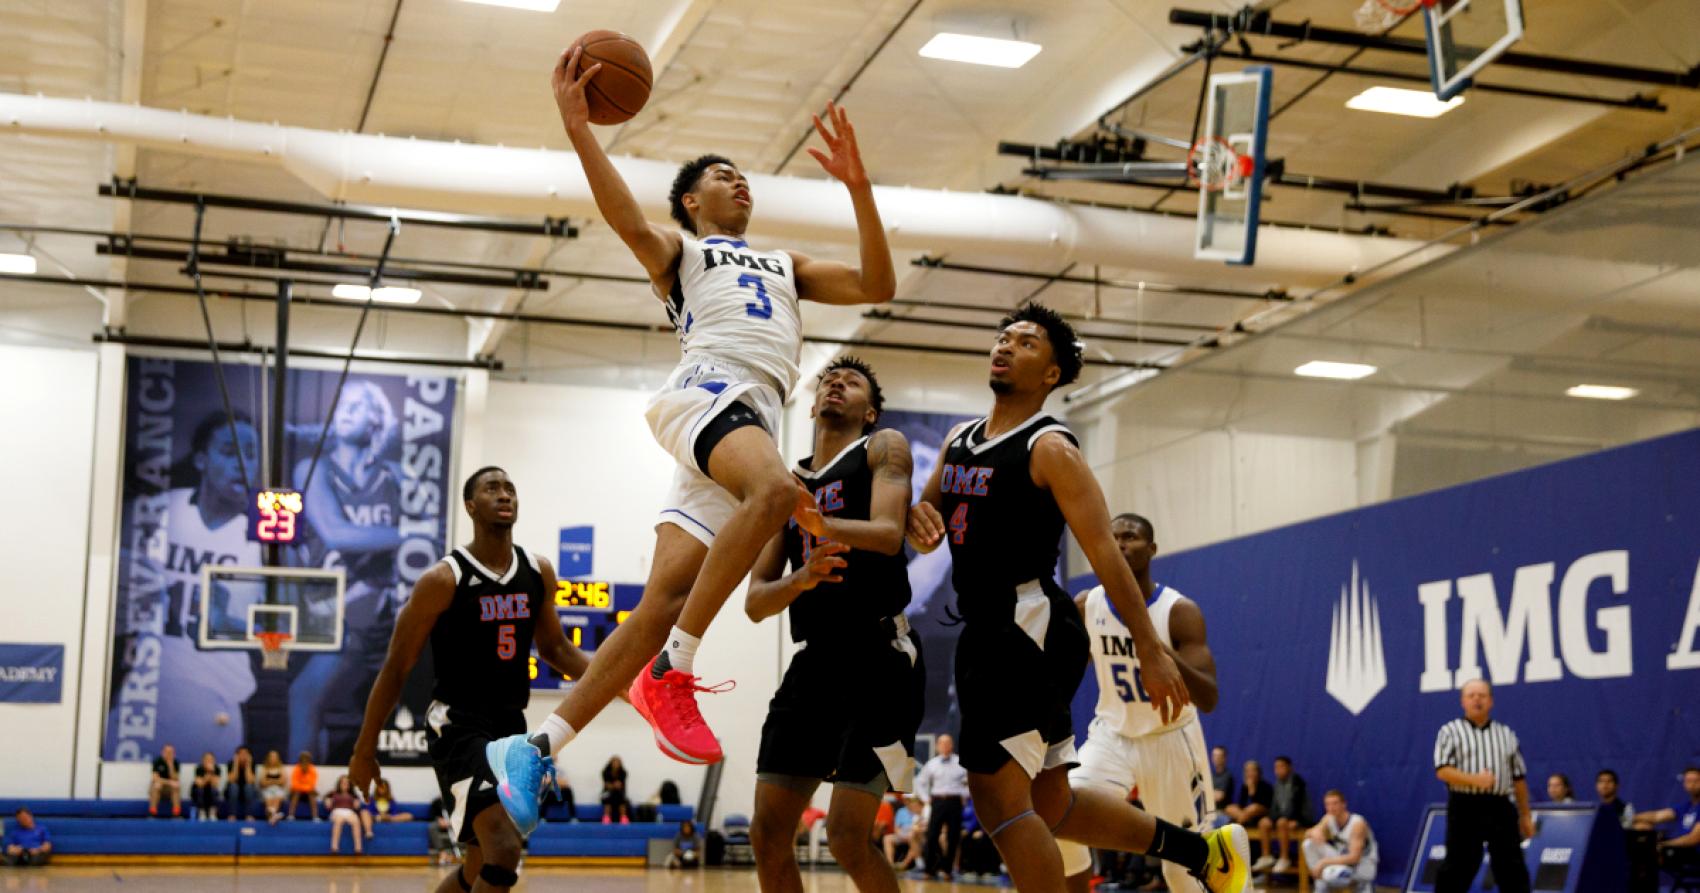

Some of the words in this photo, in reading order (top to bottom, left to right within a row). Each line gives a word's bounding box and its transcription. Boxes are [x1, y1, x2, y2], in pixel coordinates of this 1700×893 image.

[702, 248, 785, 277] IMG
[738, 273, 772, 320] 3
[397, 375, 447, 602] PASSIO
[940, 464, 993, 496] DME
[257, 509, 296, 541] 23
[343, 503, 391, 528] MG
[950, 502, 968, 544] 4
[480, 594, 530, 621] DME
[554, 580, 610, 608] 2:46
[1418, 550, 1632, 692] IMG
[497, 625, 516, 659] 5
[573, 627, 581, 647] 1
[1101, 635, 1135, 658] IM
[377, 729, 428, 752] IMG
